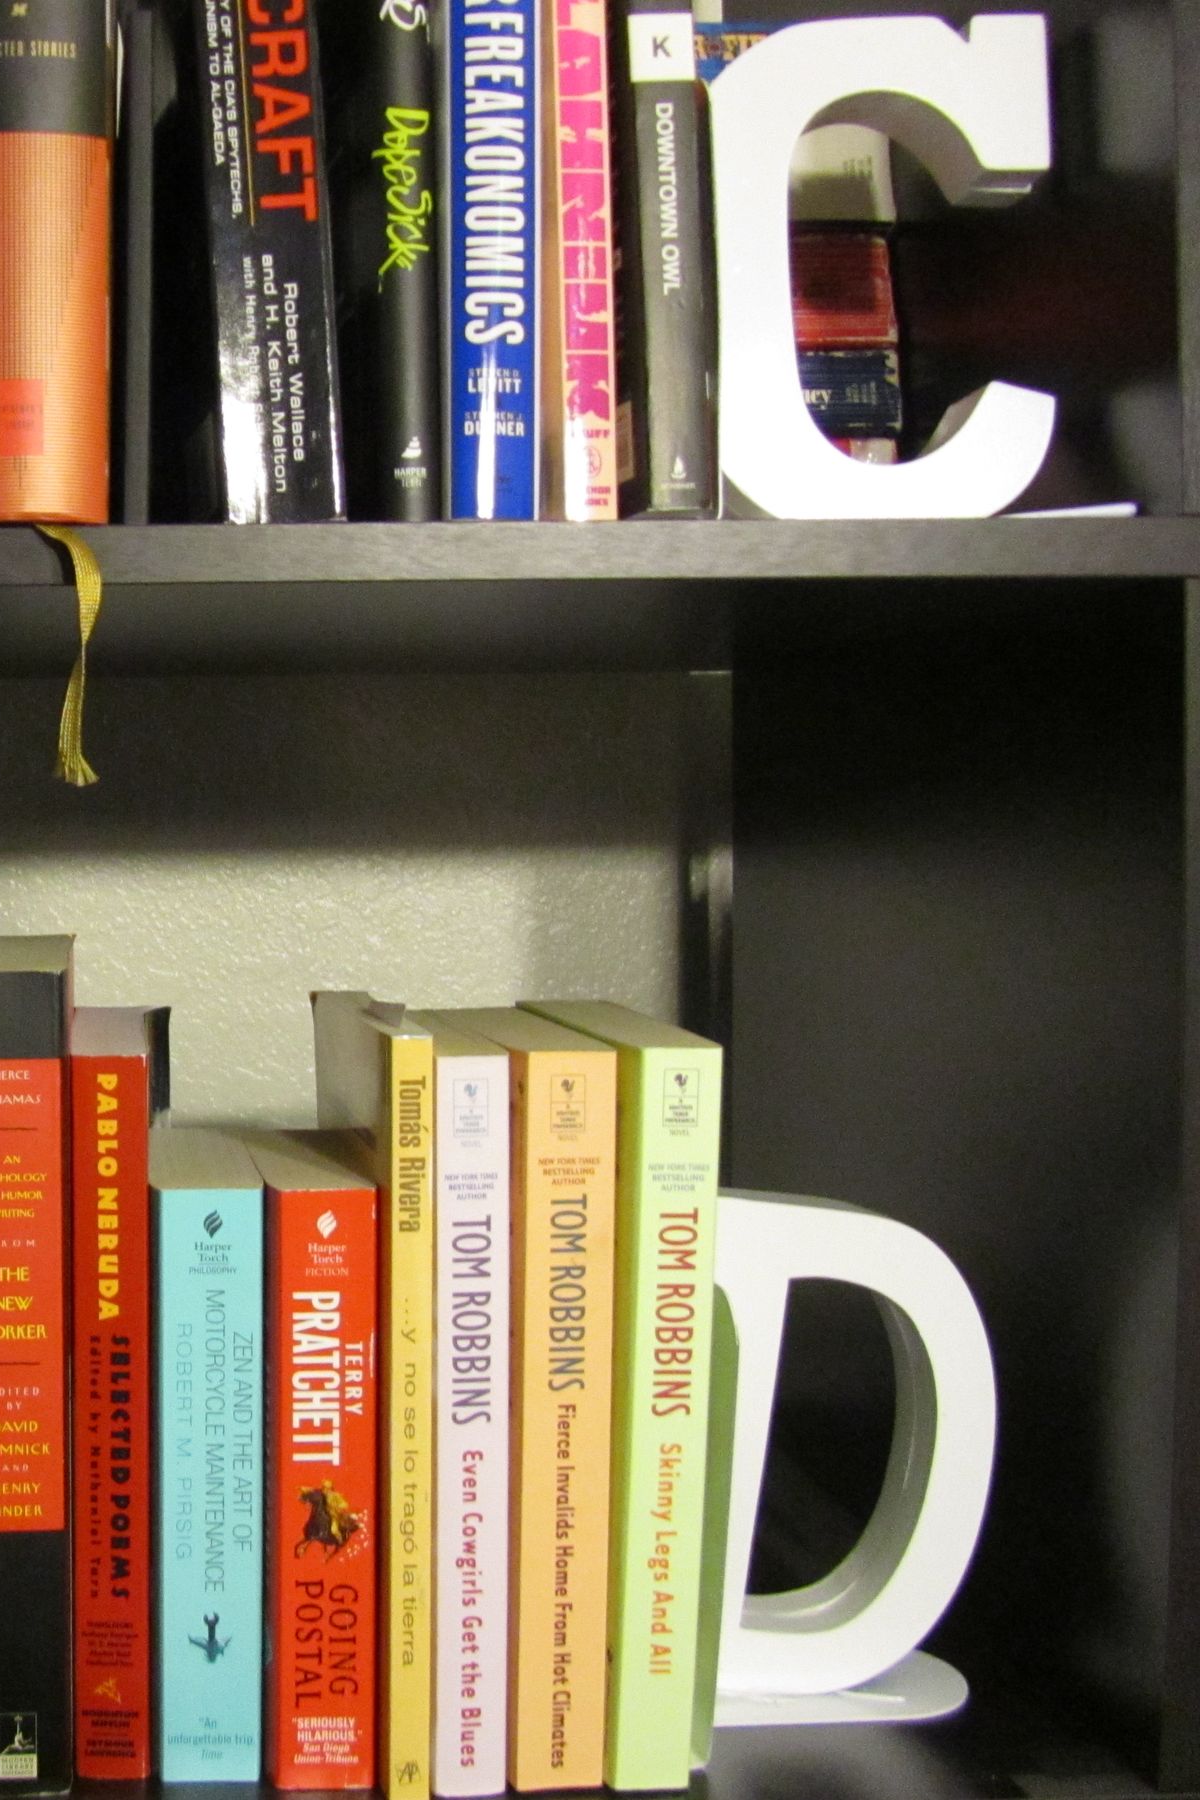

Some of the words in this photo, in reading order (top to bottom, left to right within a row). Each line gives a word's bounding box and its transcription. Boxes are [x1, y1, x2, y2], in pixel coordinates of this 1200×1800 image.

[30, 39, 78, 59] STORIES
[223, 42, 235, 75] THE
[652, 37, 672, 58] K
[210, 80, 225, 166] AL-QAEDA
[655, 102, 678, 238] DOWNTOWN
[261, 253, 278, 296] and
[661, 245, 682, 296] OWL
[283, 282, 300, 365] Robert
[267, 340, 285, 402] Keith
[288, 372, 306, 462] Wallace
[270, 410, 289, 493] Melton
[97, 1072, 119, 1178] PABLO
[398, 1075, 429, 1148] Tomás
[1, 1191, 43, 1201] HUMOR
[398, 1156, 426, 1233] Rivera
[543, 1167, 595, 1176] BESTSELLING
[551, 1177, 586, 1186] AUTHOR
[661, 1183, 696, 1192] AUTHOR
[194, 1242, 232, 1253] Harper
[307, 1242, 347, 1254] Harper
[451, 1214, 492, 1279] TOM
[549, 1192, 588, 1254] TOM
[656, 1207, 698, 1271] TOM
[96, 1187, 120, 1321] NERUDA
[188, 1266, 237, 1276] PHILOSOPHY
[197, 1253, 229, 1264] Torch
[305, 1267, 350, 1277] FICTION
[311, 1254, 343, 1265] Torch
[233, 1330, 254, 1373] ZEN
[451, 1290, 492, 1425] ROBBINS
[548, 1264, 587, 1393] ROBBINS
[650, 1282, 696, 1418] ROBBINS
[176, 1322, 193, 1427] ROBERT
[204, 1289, 226, 1437] MOTORCYCLE
[291, 1290, 341, 1466] PRATCHETT
[345, 1341, 363, 1416] TERRY
[403, 1361, 417, 1398] no
[109, 1335, 132, 1485] SELECTED
[233, 1379, 253, 1424] AND
[403, 1406, 417, 1440] se
[233, 1429, 253, 1471] THE
[557, 1403, 577, 1460] Fierce
[233, 1476, 253, 1517] ART
[461, 1448, 483, 1504] Even
[555, 1465, 576, 1540] Invalids
[649, 1443, 683, 1522] Skinny
[109, 1493, 132, 1601] POEMS
[176, 1477, 193, 1561] PIRSIG
[204, 1442, 226, 1593] MAINTENANCE
[232, 1522, 253, 1552] OF
[399, 1483, 419, 1554] tragó
[455, 1511, 484, 1608] Cowgirls
[554, 1545, 574, 1598] Home
[647, 1530, 678, 1582] Legs
[328, 1582, 359, 1696] GOING
[401, 1596, 419, 1667] tierra
[461, 1615, 483, 1655] Get
[553, 1602, 573, 1647] From
[650, 1590, 675, 1635] And
[293, 1578, 324, 1709] POSTAL
[552, 1652, 572, 1686] Hot
[648, 1643, 673, 1676] All
[461, 1661, 482, 1699] the
[303, 1743, 321, 1754] San
[460, 1706, 482, 1768] Blues
[551, 1690, 572, 1769] Climates
